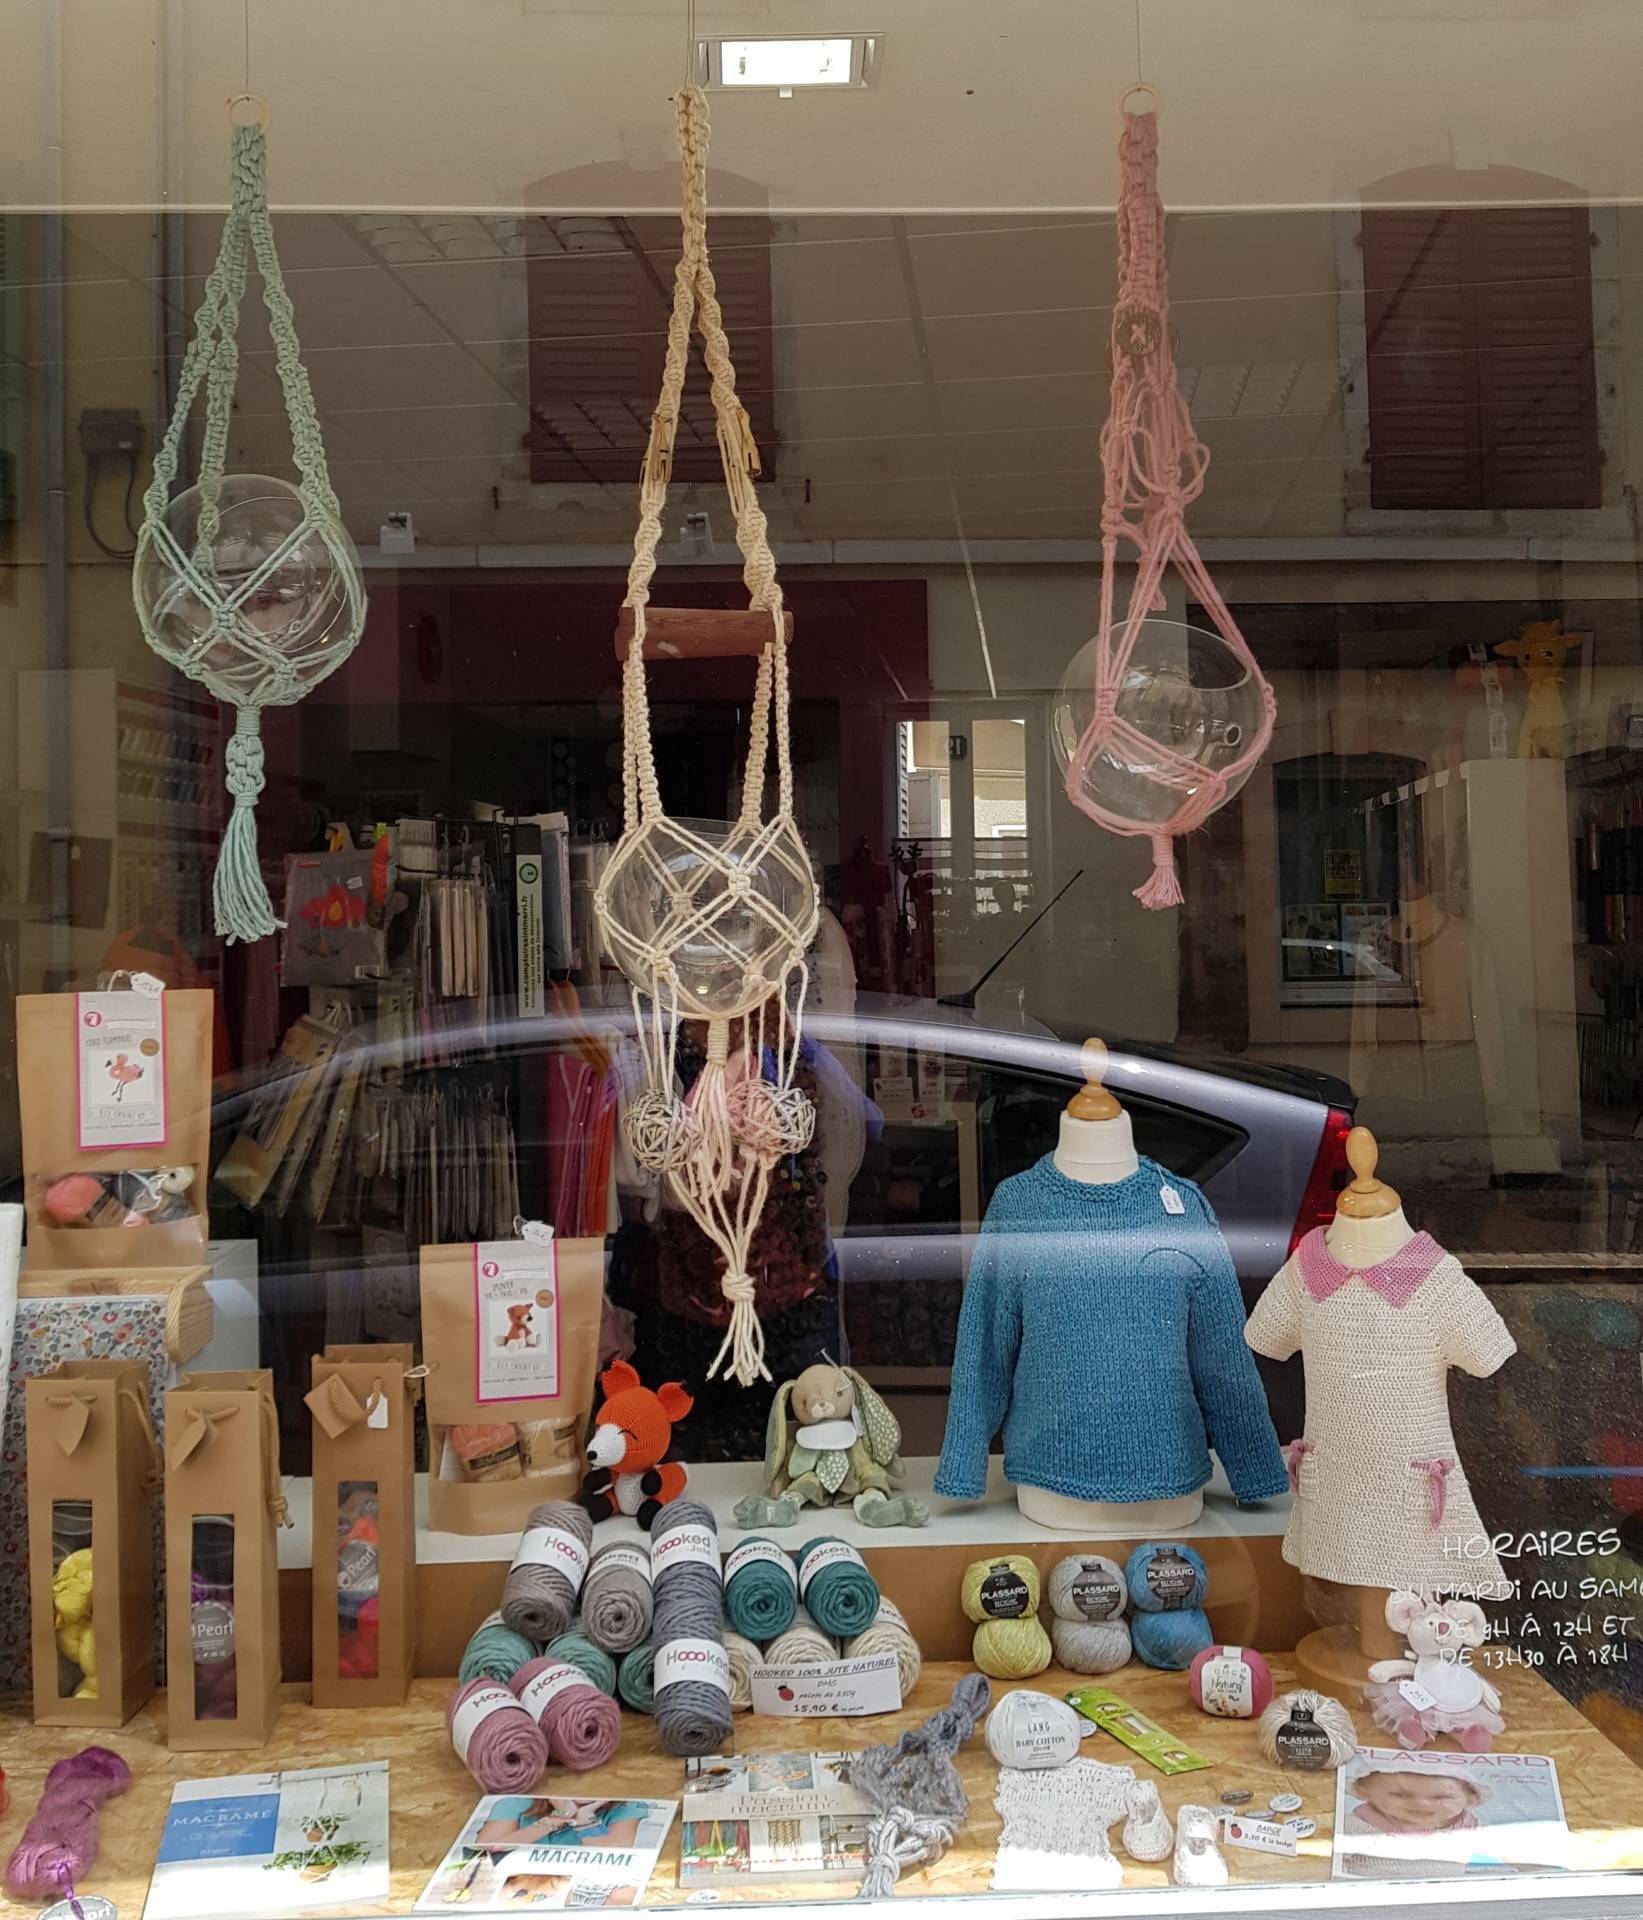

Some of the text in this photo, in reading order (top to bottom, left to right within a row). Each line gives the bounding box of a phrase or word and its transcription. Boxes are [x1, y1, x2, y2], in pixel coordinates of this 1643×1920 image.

[653, 1532, 711, 1562] Hoooked
[1147, 1568, 1195, 1579] PLASSARD
[981, 1586, 1028, 1600] PLASSARD
[1073, 1584, 1120, 1596] PLASSARD
[1531, 1579, 1568, 1600] AU
[197, 1620, 233, 1638] Pearl
[1435, 1618, 1469, 1640] DE
[1483, 1616, 1510, 1640] 9H
[1553, 1615, 1592, 1637] 12H
[1603, 1616, 1636, 1636] ET
[666, 1649, 729, 1675] Hoooked
[1439, 1648, 1474, 1667] DE
[1484, 1649, 1544, 1669] 13H30
[1588, 1643, 1628, 1665] 18H
[753, 1669, 795, 1678] HOOKED
[825, 1665, 851, 1675] JUTE
[852, 1657, 897, 1672] NATUREL
[793, 1704, 828, 1713] 15,90
[831, 1703, 840, 1712] €
[1027, 1721, 1051, 1734] LANG
[1016, 1735, 1066, 1748] BABY COTTON
[1277, 1735, 1329, 1746] PLASSARD
[1257, 1824, 1282, 1835] BADGE
